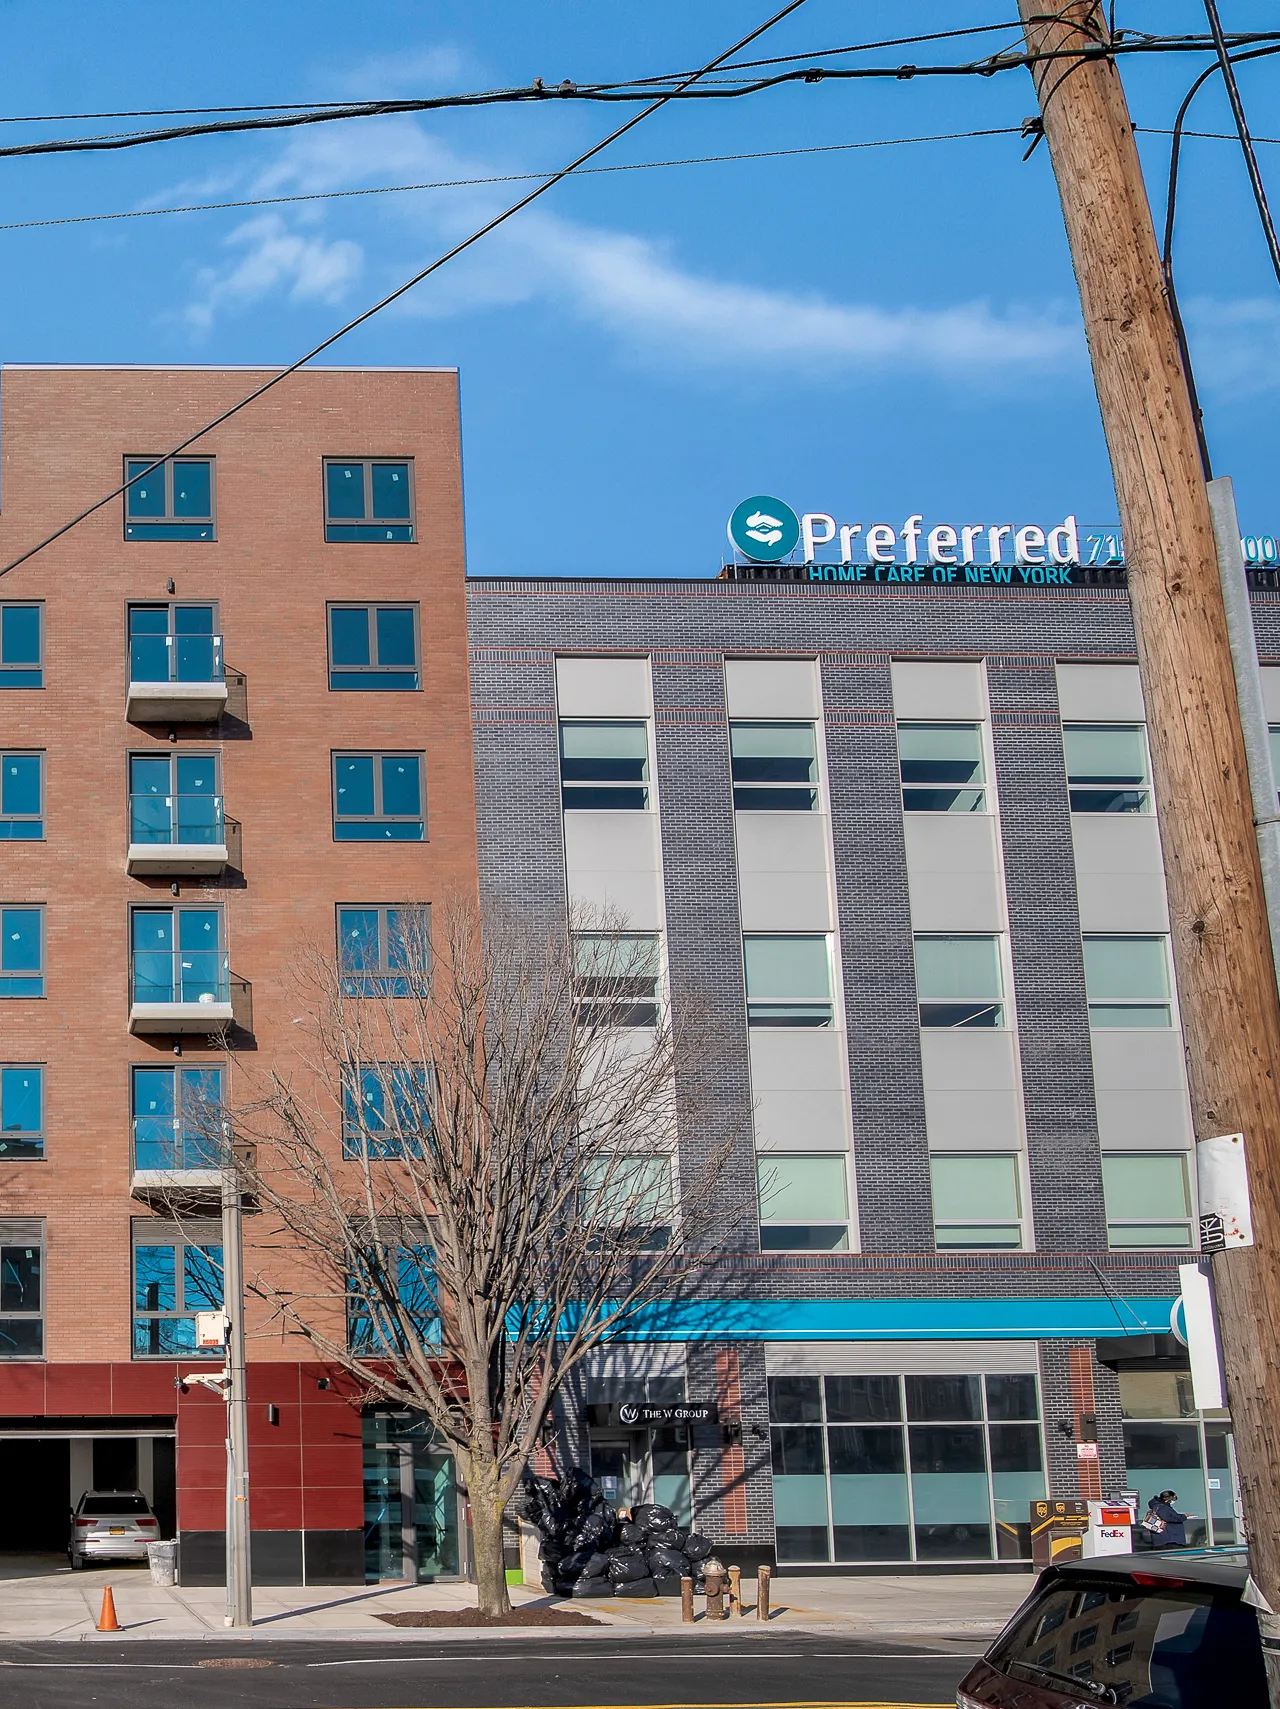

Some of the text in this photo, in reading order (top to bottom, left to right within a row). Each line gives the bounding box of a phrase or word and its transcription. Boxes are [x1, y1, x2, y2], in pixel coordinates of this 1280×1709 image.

[802, 513, 1079, 565] Preferred
[1087, 534, 1124, 565] 71
[809, 566, 1072, 584] HOME CARE OF NEW YORK
[643, 1409, 661, 1418] THE
[663, 1409, 673, 1418] W
[674, 1409, 709, 1418] GROUP
[1101, 1529, 1124, 1538] FedEx
